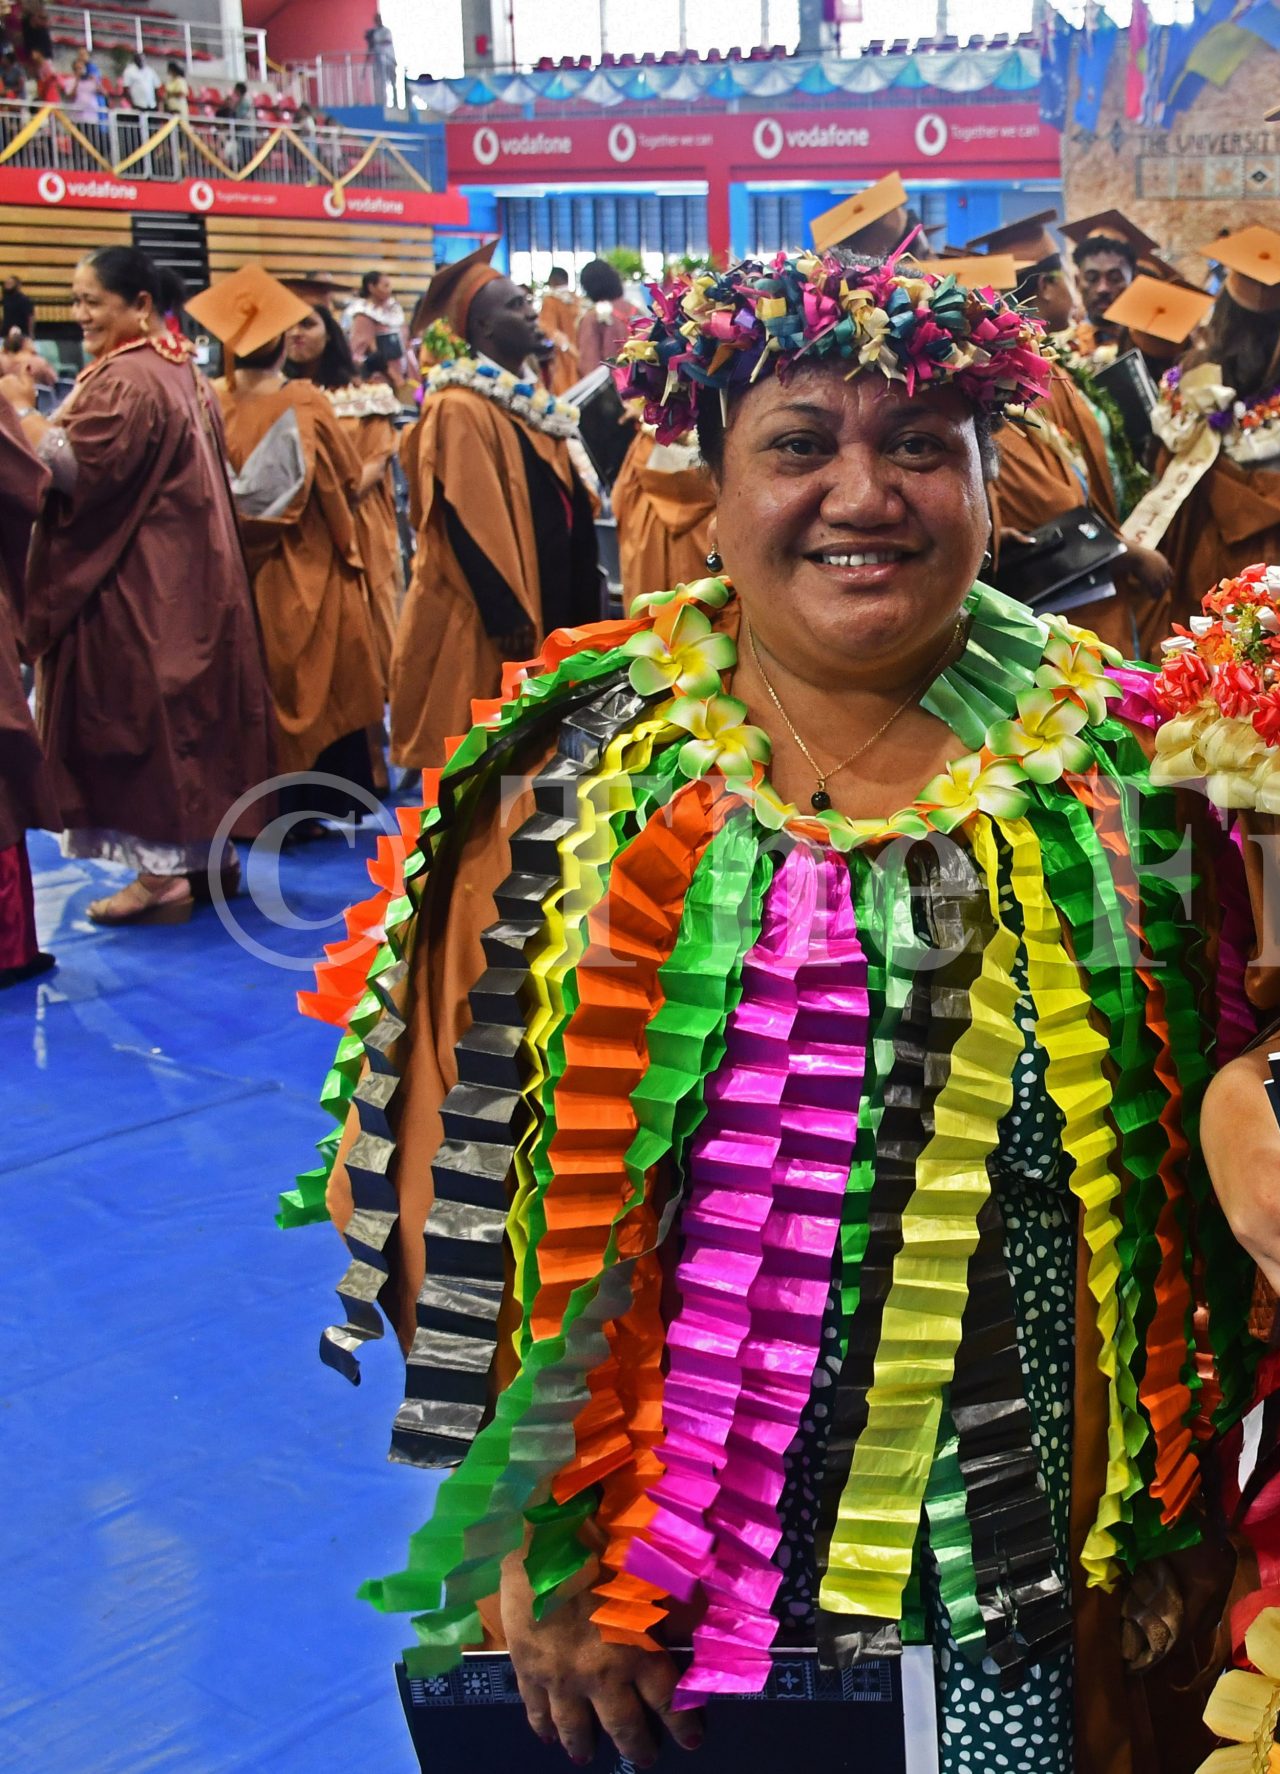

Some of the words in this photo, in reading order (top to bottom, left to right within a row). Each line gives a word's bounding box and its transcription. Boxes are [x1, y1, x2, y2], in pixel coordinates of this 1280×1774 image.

[501, 133, 572, 154] vodafone
[786, 123, 870, 148] vodafone
[951, 124, 999, 143] Together
[67, 180, 138, 200] vodafone
[347, 197, 405, 215] vodafone
